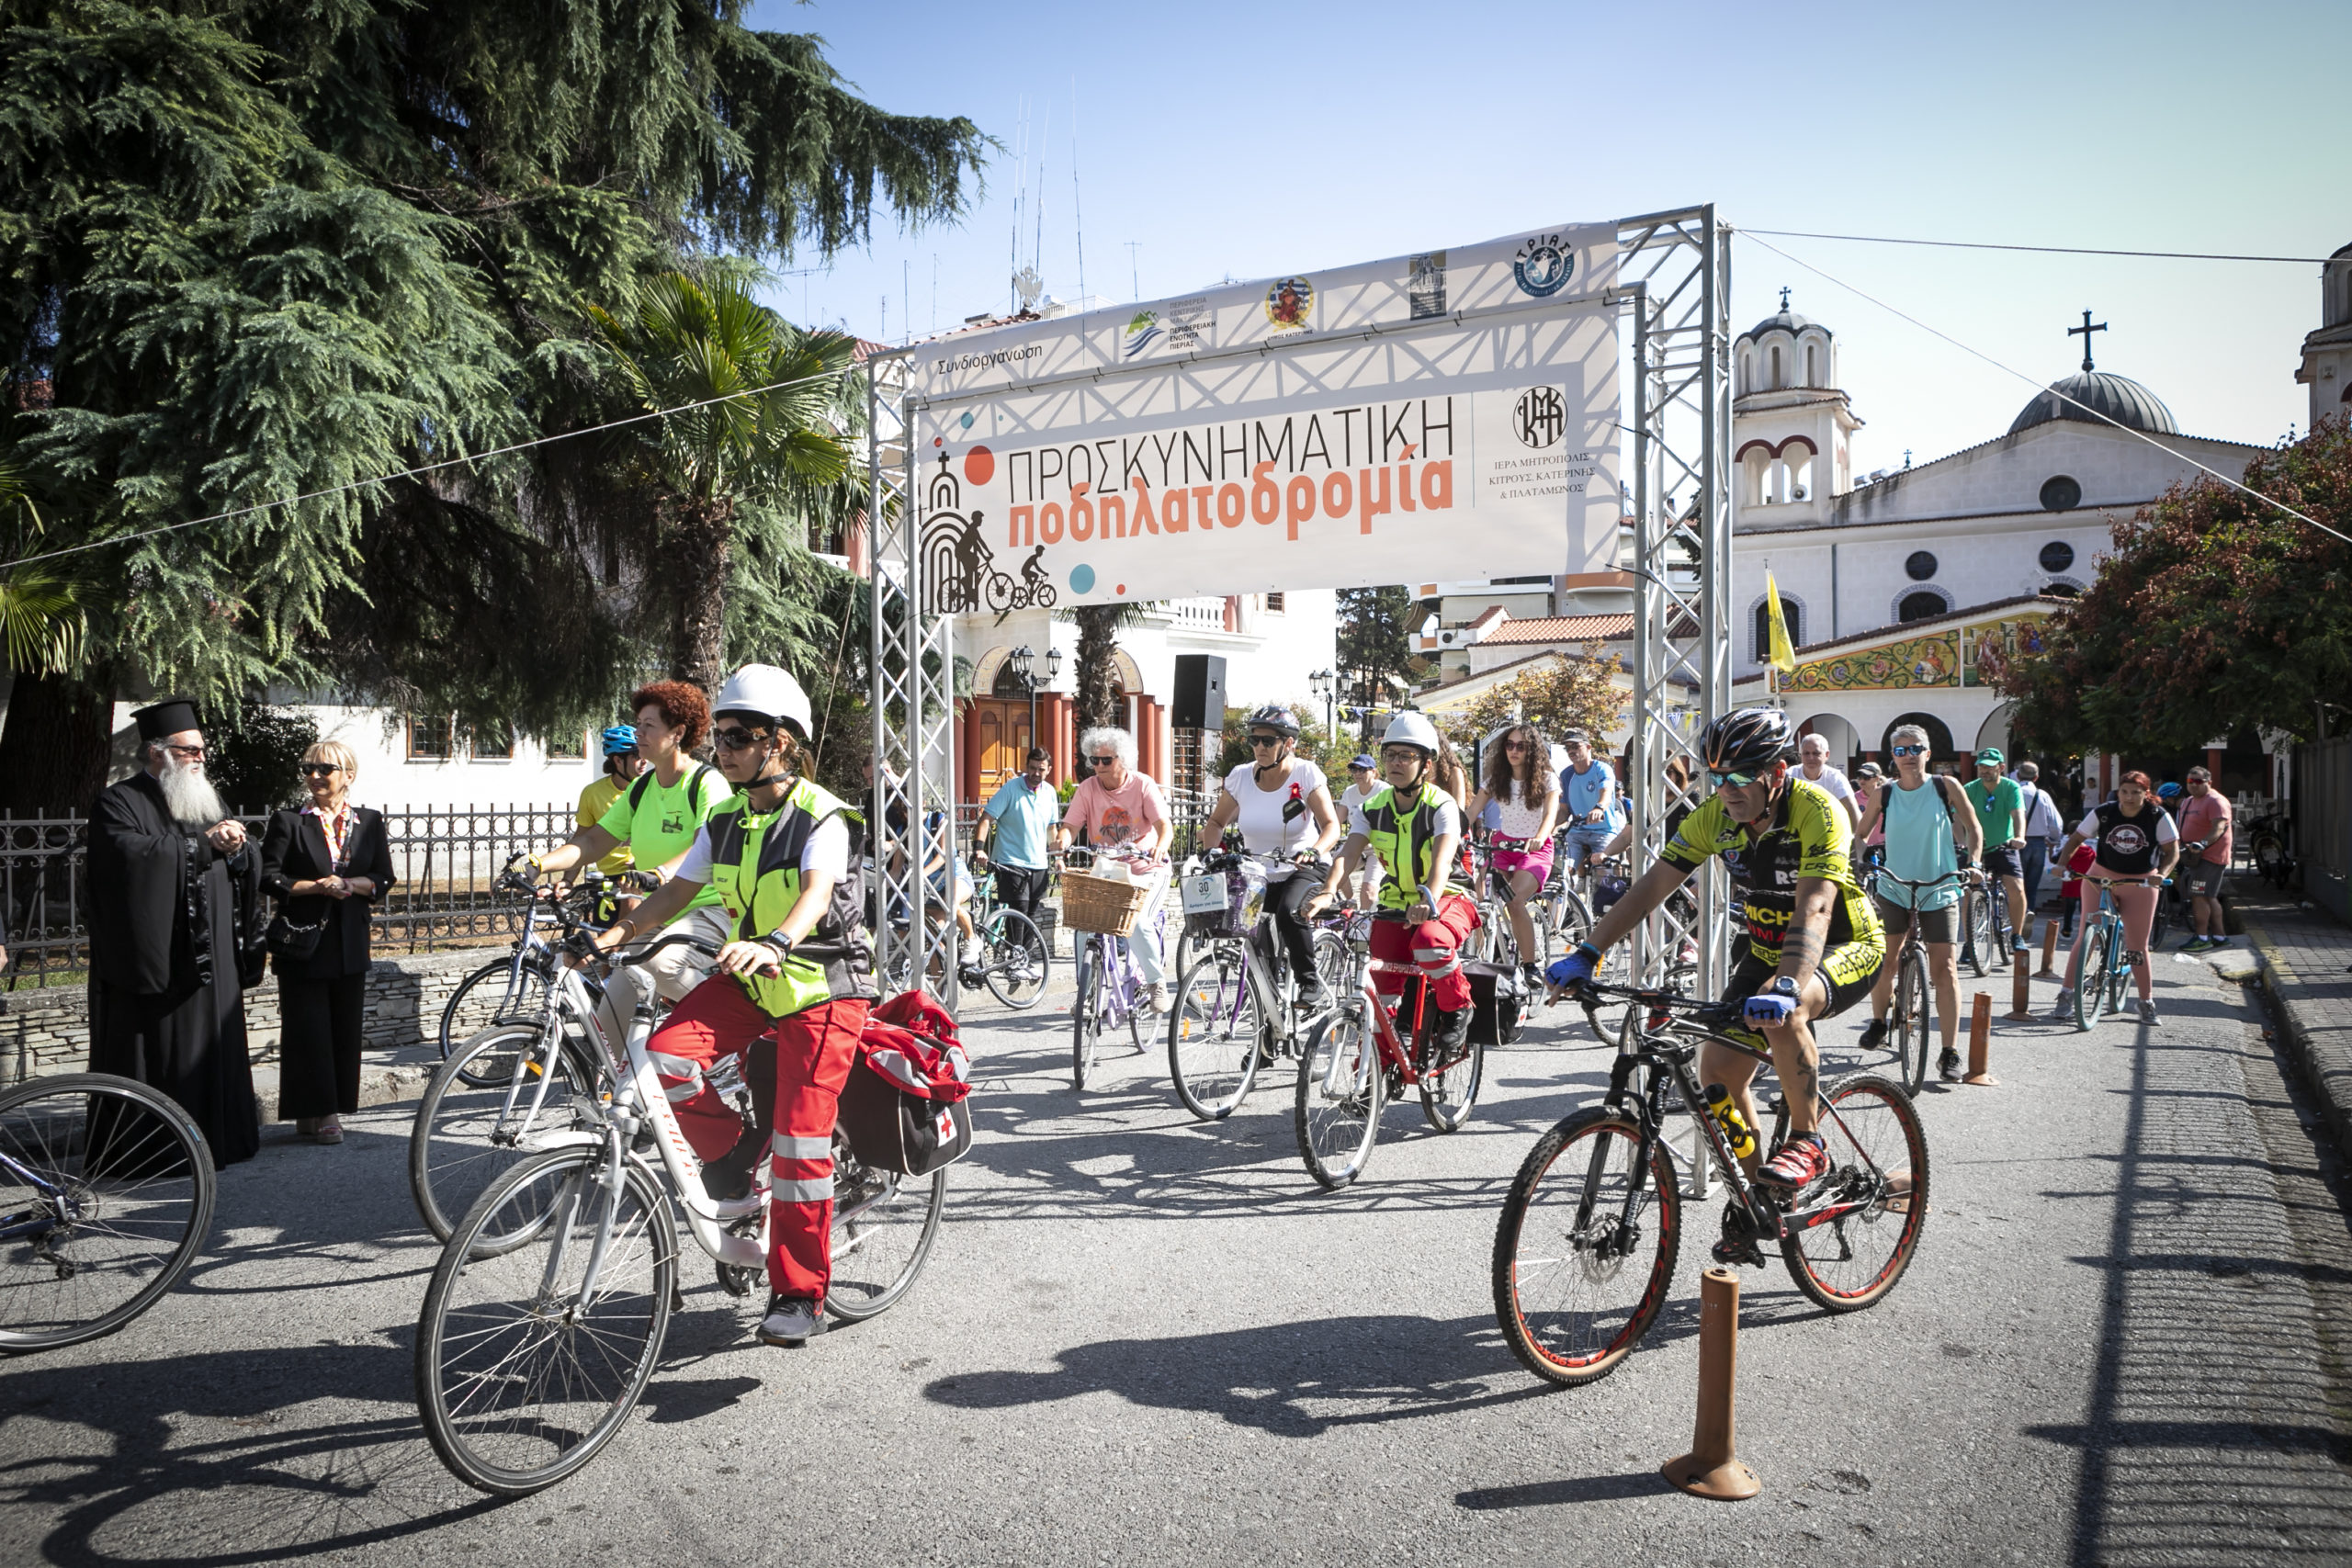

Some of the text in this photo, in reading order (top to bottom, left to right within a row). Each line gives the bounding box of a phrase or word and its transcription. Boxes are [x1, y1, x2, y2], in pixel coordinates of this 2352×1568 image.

[1516, 234, 1571, 258] ΤΡΙΑΣ
[1170, 297, 1207, 309] ΠΕΡΙΦΕΡΕΙΑ
[1170, 305, 1204, 316] ΚΕΝΤΡΙΚΗΣ
[1170, 321, 1216, 334] ΠΕΡΙΦΕΡΕΙΑΚΗ
[1170, 332, 1199, 342] ΕΝΟΤΗΤΑ
[1170, 340, 1194, 350] ΠΙΕΡΙΑΣ
[938, 345, 1043, 375] Συνδιοργάνωση
[1009, 396, 1453, 503] ΠΡΟΣΚΥΝΗΜΑΤΙΚΗ
[1494, 452, 1589, 469] ΙΕΡΑ ΜΗΤΡΟΠΟΛΙΣ
[1536, 467, 1596, 481] ΚΑΤΕΡΙΝΗΣ
[1008, 443, 1453, 548] ποδηλατοδρομία
[1500, 483, 1584, 499] & ΠΛΑΤΑΜΩΝΟΣ
[1198, 881, 1209, 893] 30
[1680, 1063, 1750, 1192] BOTTECCHIA
